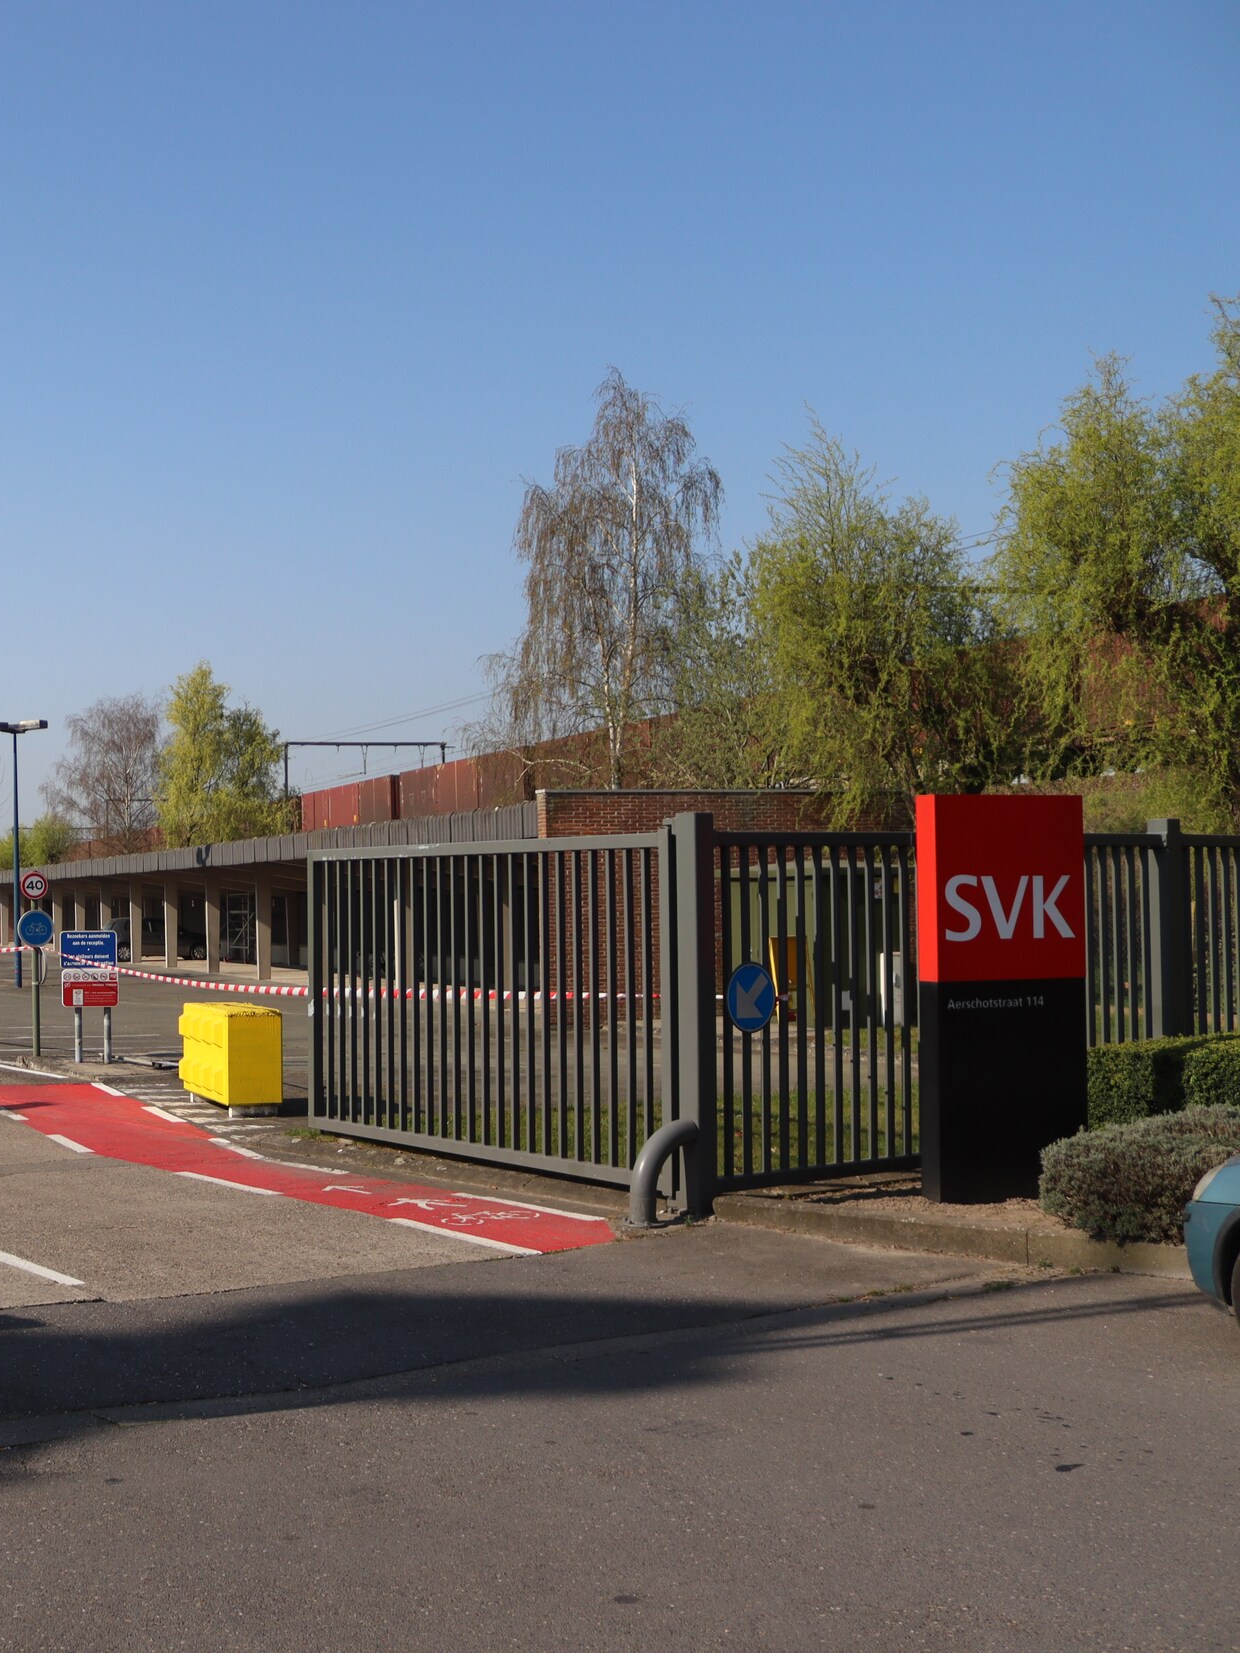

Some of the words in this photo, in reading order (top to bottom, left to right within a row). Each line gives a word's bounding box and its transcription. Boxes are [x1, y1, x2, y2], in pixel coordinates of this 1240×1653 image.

[26, 880, 44, 891] 40
[945, 874, 1076, 942] SVK
[947, 997, 1023, 1009] Aerschotstraat
[1026, 995, 1045, 1006] 114
